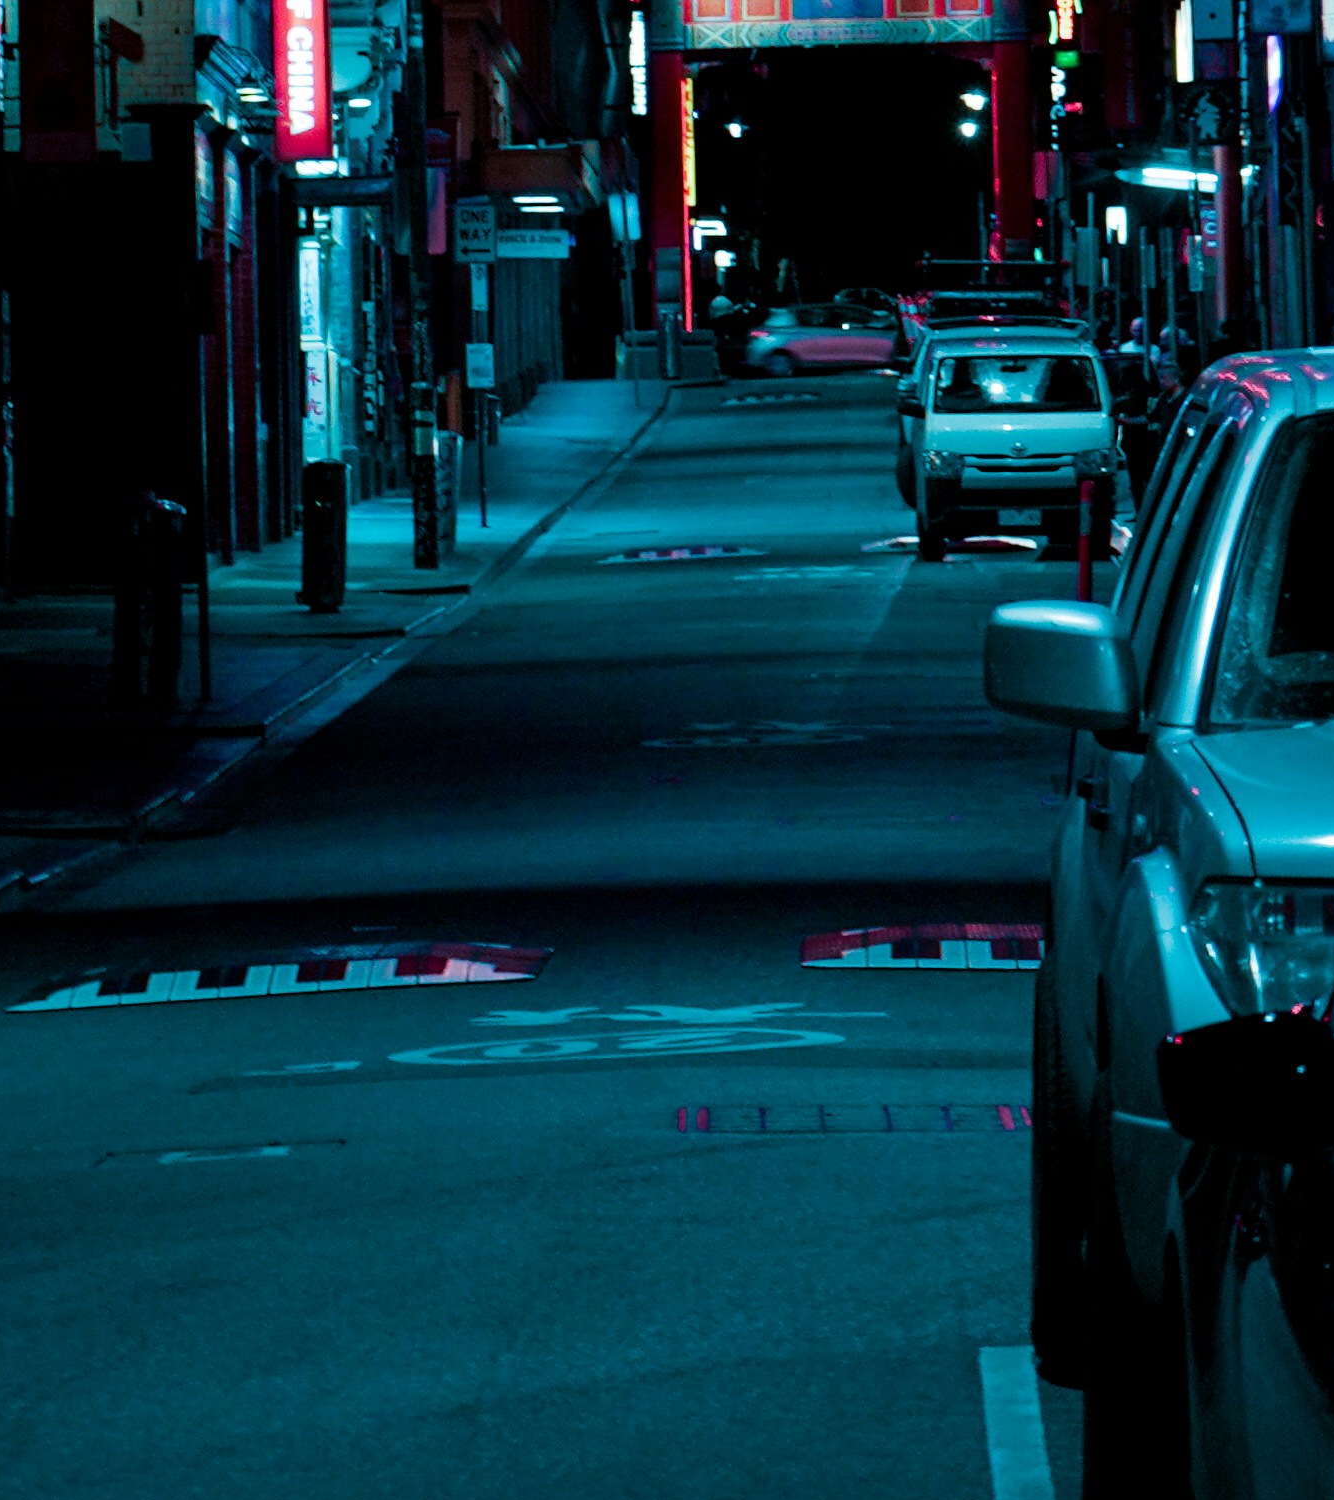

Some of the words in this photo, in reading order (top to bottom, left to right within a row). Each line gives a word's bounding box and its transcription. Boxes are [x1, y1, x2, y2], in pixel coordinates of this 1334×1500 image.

[286, 26, 315, 136] CHINA
[460, 209, 489, 223] ONE
[459, 228, 491, 240] WAY
